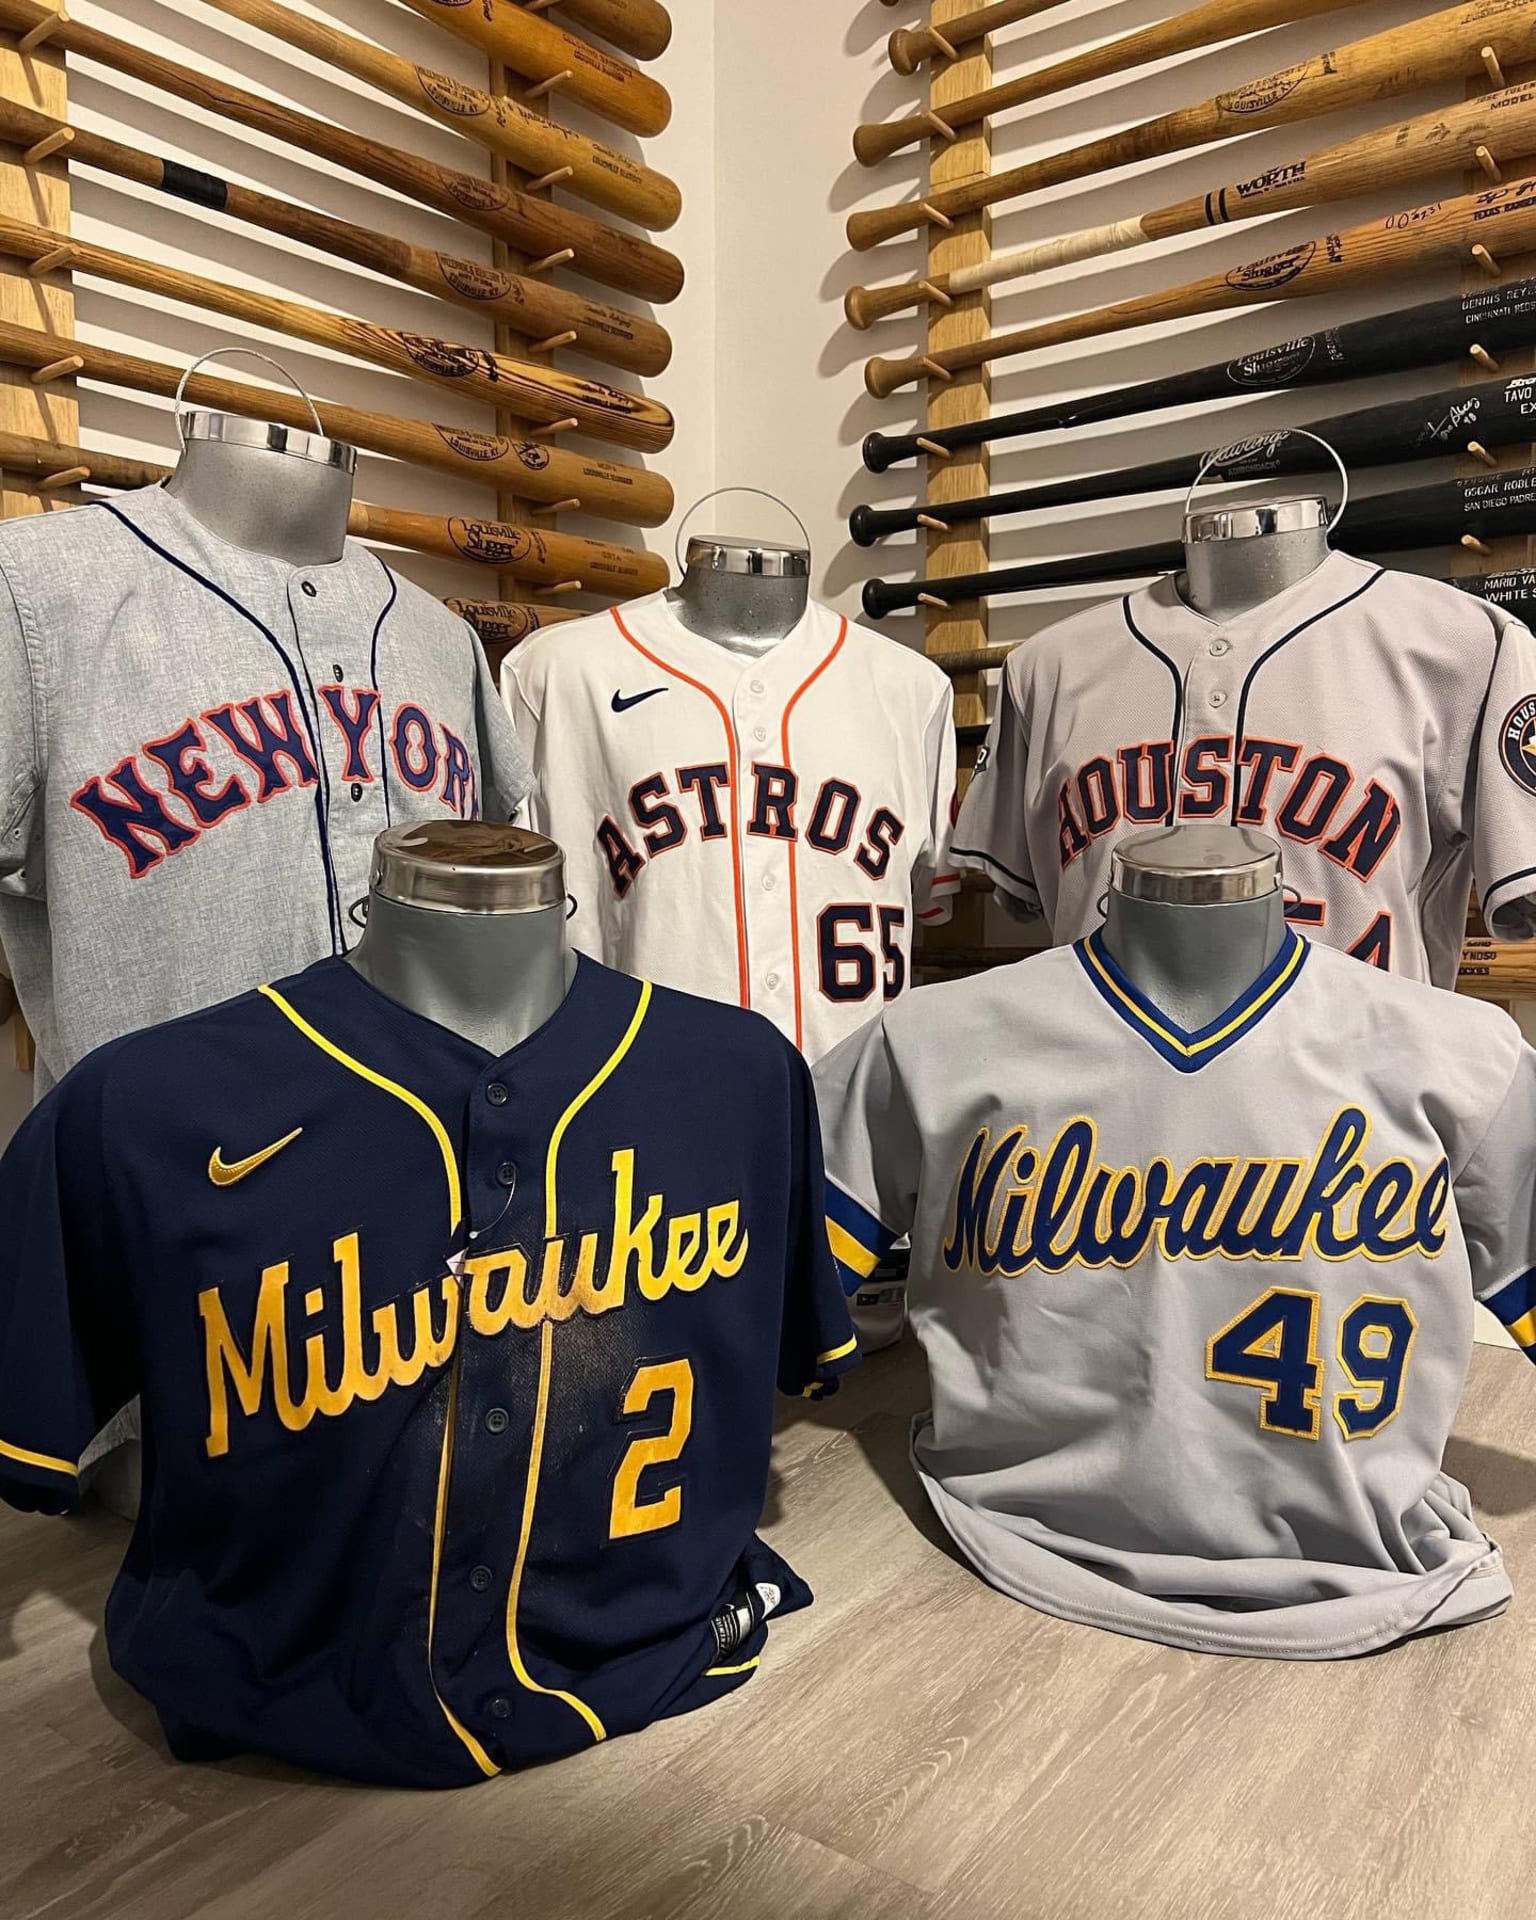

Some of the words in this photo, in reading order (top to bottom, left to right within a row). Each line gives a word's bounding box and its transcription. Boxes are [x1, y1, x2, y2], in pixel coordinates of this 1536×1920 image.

[1490, 93, 1535, 111] MODEL
[1236, 161, 1307, 194] WORTH
[1241, 254, 1301, 281] Slugger
[1237, 337, 1310, 367] Louisville
[1504, 386, 1533, 404] TAVO
[1464, 483, 1499, 498] OSCAR
[1464, 501, 1481, 512] SAN
[1482, 496, 1508, 510] DIEGO
[460, 518, 521, 540] Louisville
[466, 531, 517, 560] Slugger
[1484, 576, 1517, 590] MARIO
[1485, 588, 1529, 602] WHITE
[456, 599, 517, 619] Louisville
[70, 688, 321, 880] NEW
[317, 684, 480, 823] YOR
[1058, 734, 1403, 884] HOUSTON
[597, 761, 905, 900] ASTROS
[816, 902, 906, 1003] 65
[942, 1102, 1451, 1279] Milwaukee
[198, 1147, 750, 1459] Milwaukee
[1204, 1285, 1420, 1442] 49
[608, 1356, 695, 1541] 2
